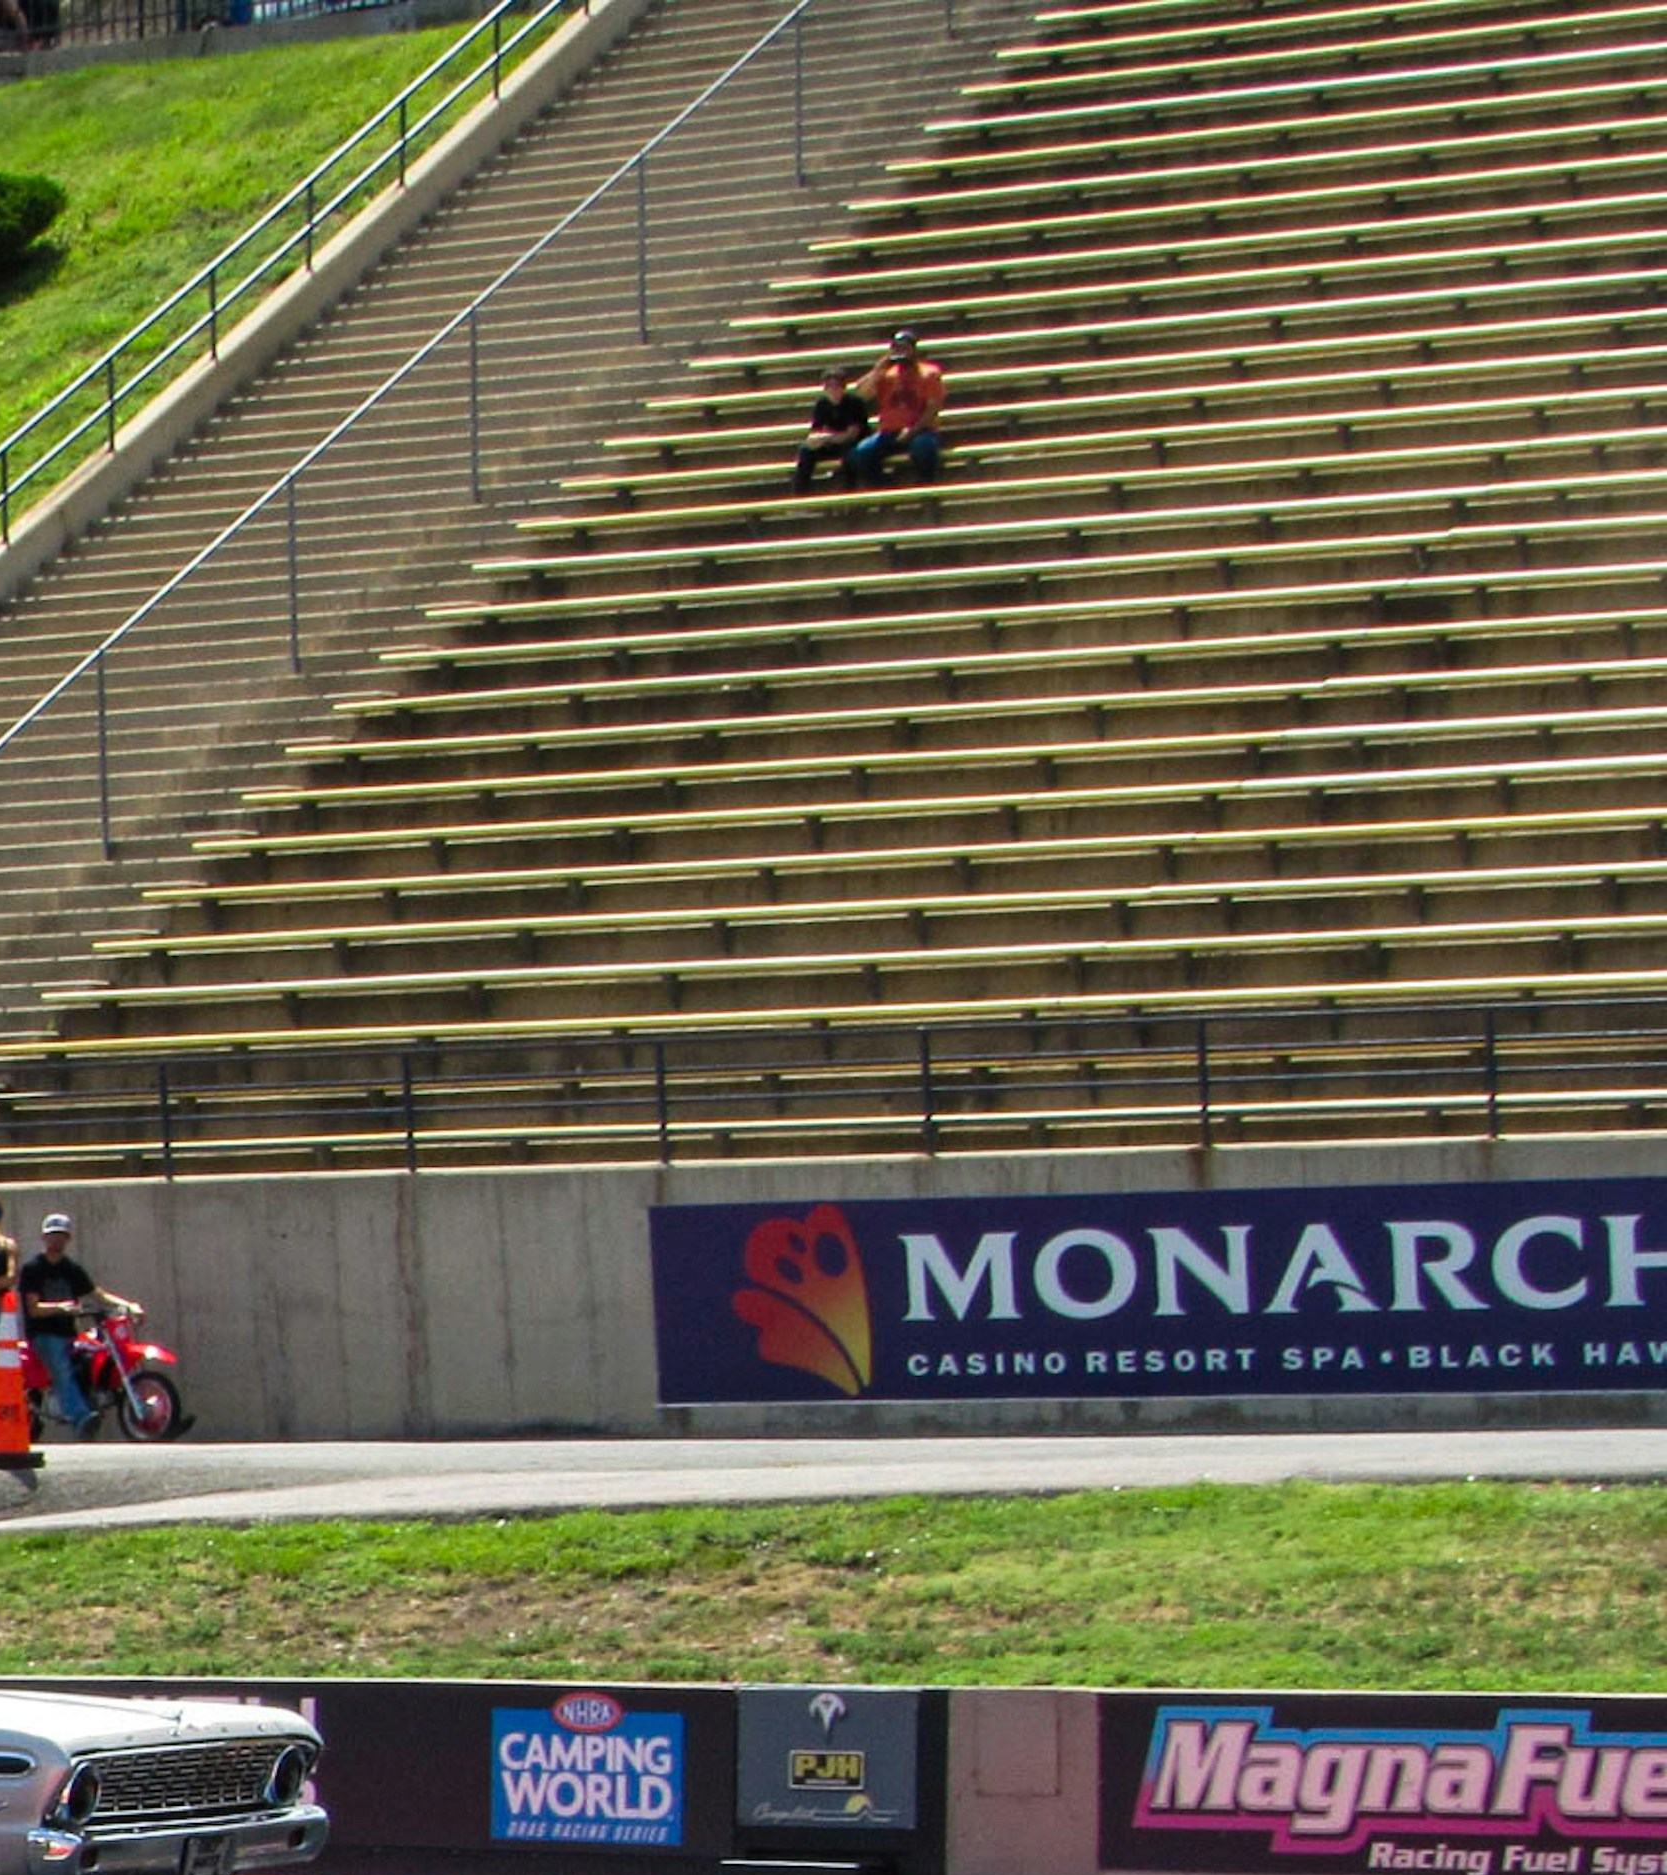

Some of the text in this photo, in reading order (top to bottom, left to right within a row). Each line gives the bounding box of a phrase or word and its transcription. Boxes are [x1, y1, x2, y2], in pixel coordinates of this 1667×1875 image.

[898, 1214, 1667, 1322] MONARCH
[907, 1352, 1066, 1376] CASINO
[1086, 1349, 1255, 1373] RESORT
[1282, 1347, 1365, 1370] SPA
[1407, 1344, 1555, 1368] BLACK
[563, 1698, 611, 1724] NHRA
[499, 1733, 673, 1775] CAMPING
[795, 1755, 860, 1777] PJH
[501, 1771, 673, 1820] WORLD
[508, 1821, 668, 1843] DRAG RACING SERIES
[1368, 1842, 1491, 1875] Racing
[1503, 1845, 1579, 1873] Fuel
